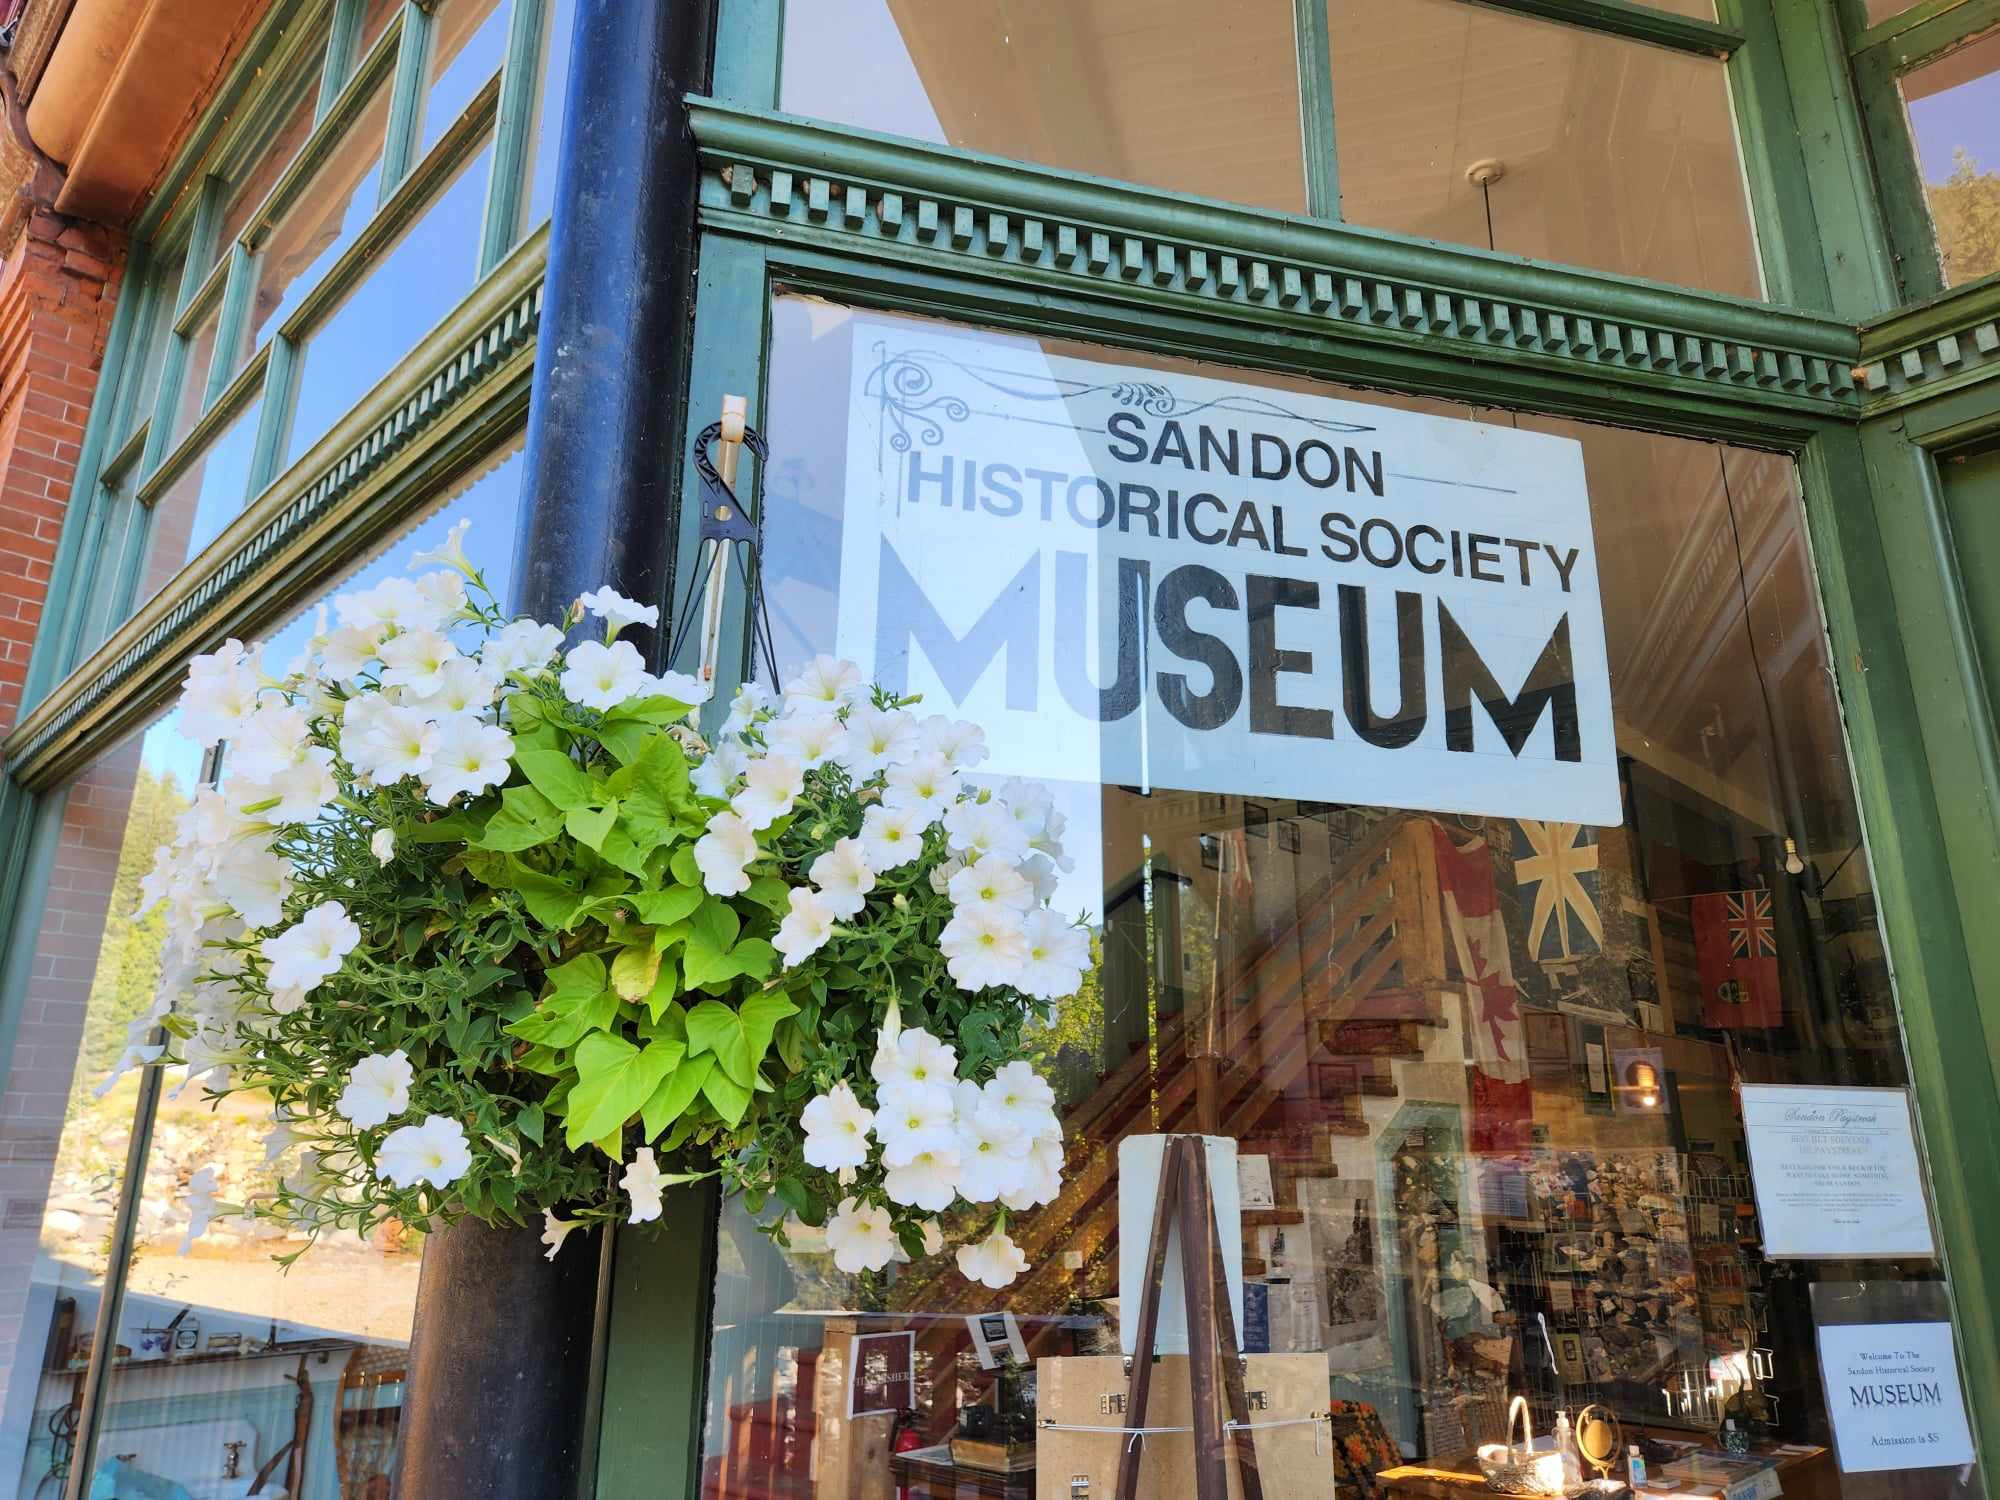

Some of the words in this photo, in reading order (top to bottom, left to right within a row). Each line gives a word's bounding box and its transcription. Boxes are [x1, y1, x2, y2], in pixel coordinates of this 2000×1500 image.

[1107, 411, 1385, 497] SANDON
[906, 450, 1308, 557] HISTORICAL
[1319, 511, 1580, 592] SOCIETY
[874, 531, 1582, 763] MUSEUM
[1860, 1352, 1892, 1361] Welcome
[1893, 1351, 1905, 1360] To
[1905, 1351, 1920, 1359] The
[1847, 1367, 1874, 1375] Sandon
[1875, 1365, 1909, 1374] Historical
[1910, 1365, 1936, 1374] Society
[1849, 1382, 1942, 1406] MUSEUM
[1871, 1435, 1916, 1447] Admission
[1918, 1435, 1926, 1444] is
[1927, 1432, 1940, 1443] $5
